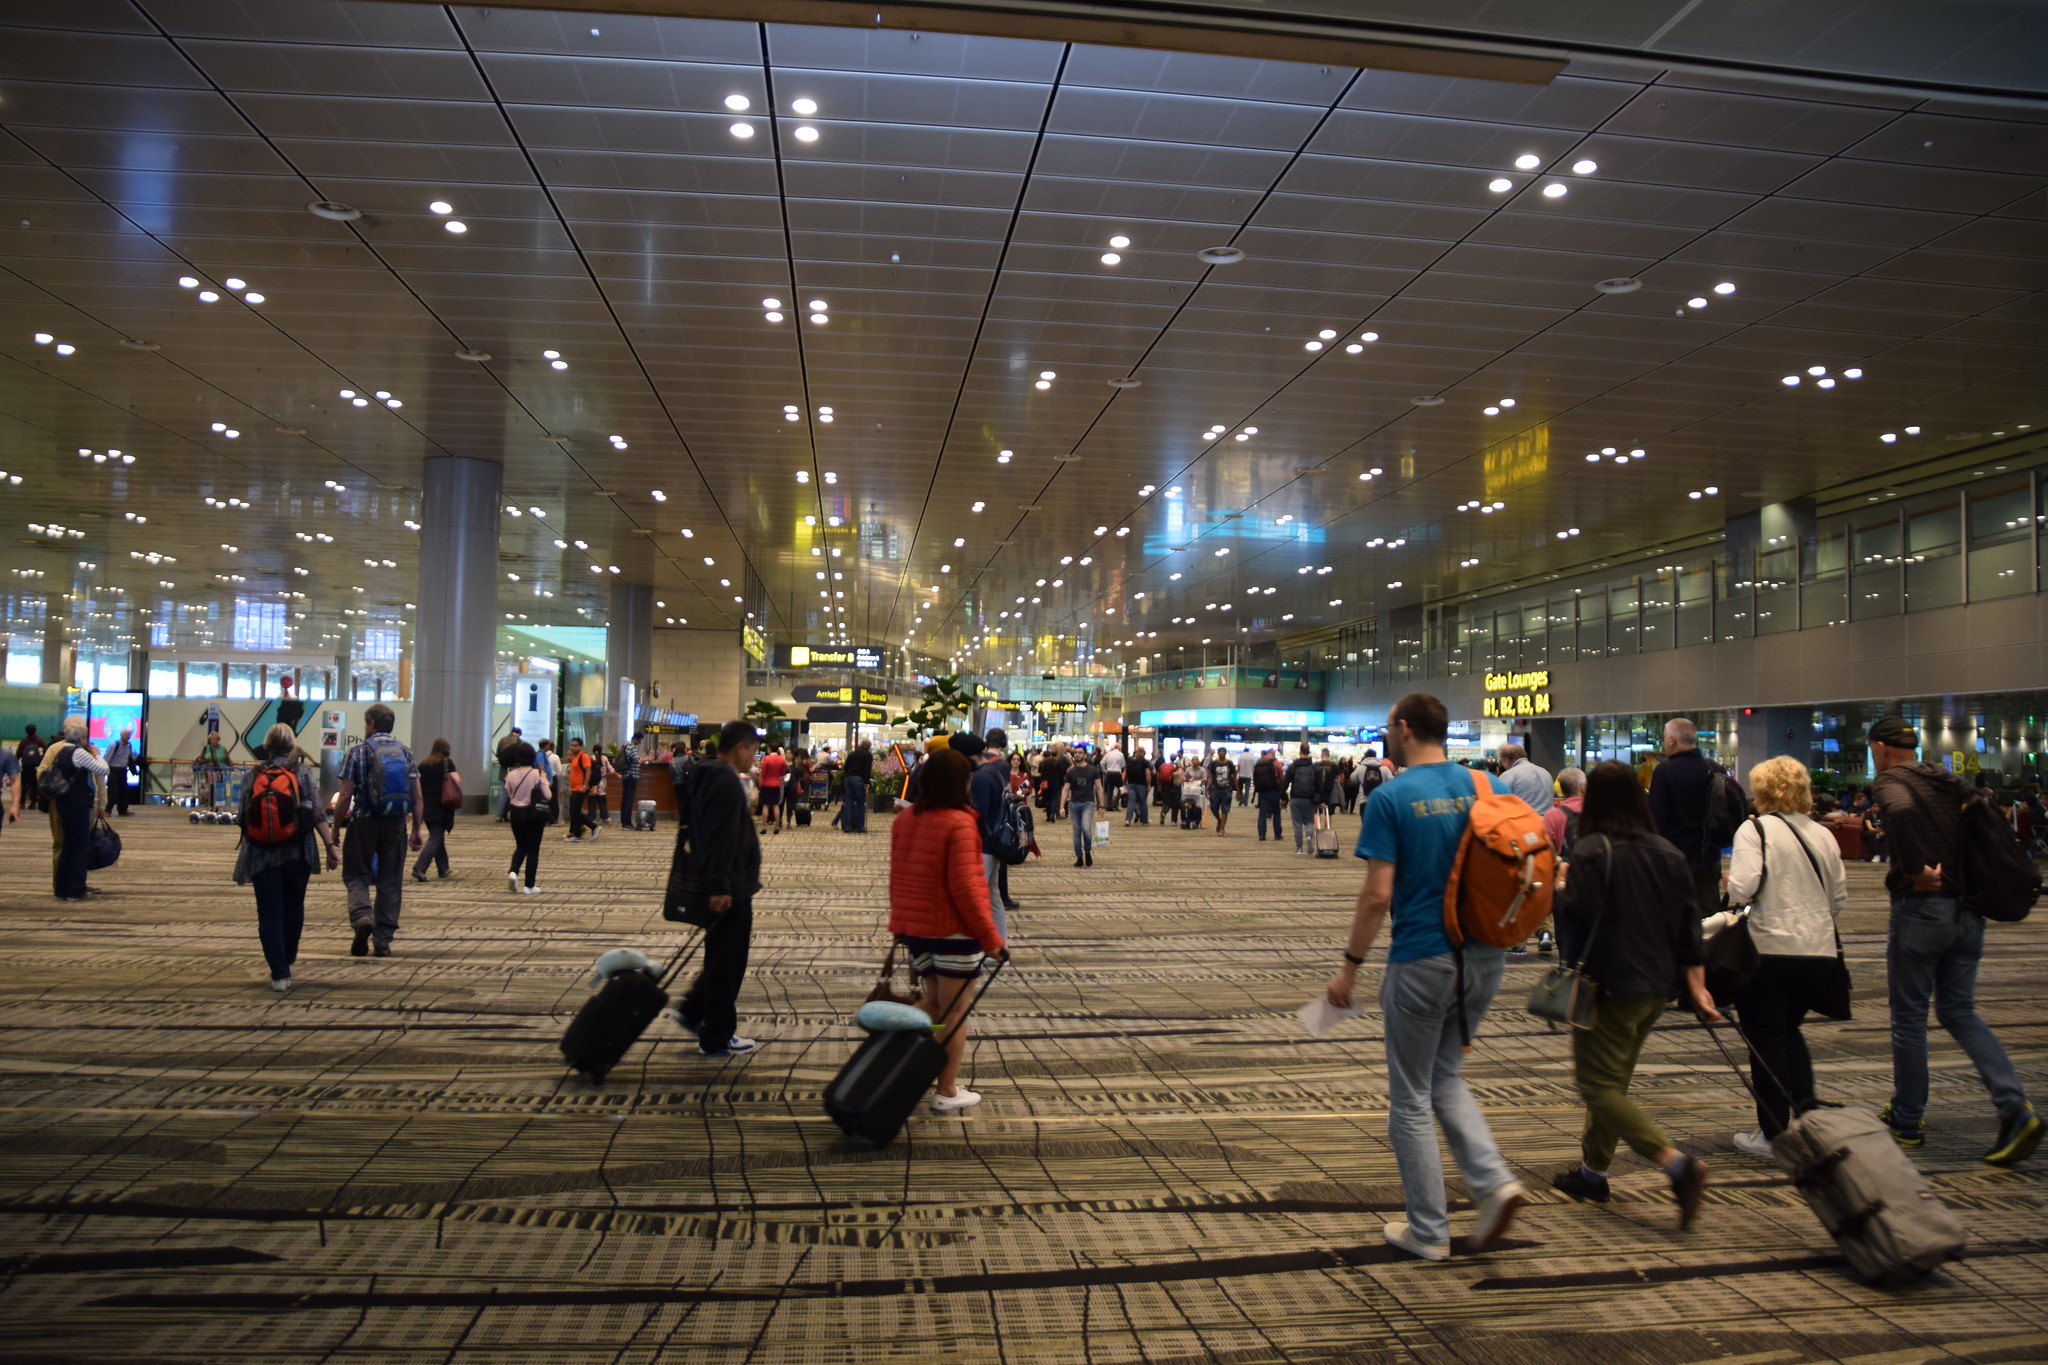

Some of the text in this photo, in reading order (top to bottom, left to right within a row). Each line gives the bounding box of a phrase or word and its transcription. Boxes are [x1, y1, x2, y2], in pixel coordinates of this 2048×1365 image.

[810, 651, 846, 663] Transfer
[1485, 670, 1549, 692] Gate Lounges
[816, 690, 840, 699] Arrival
[1483, 693, 1550, 718] B1, B2, B3, B4
[1952, 750, 1980, 776] B4
